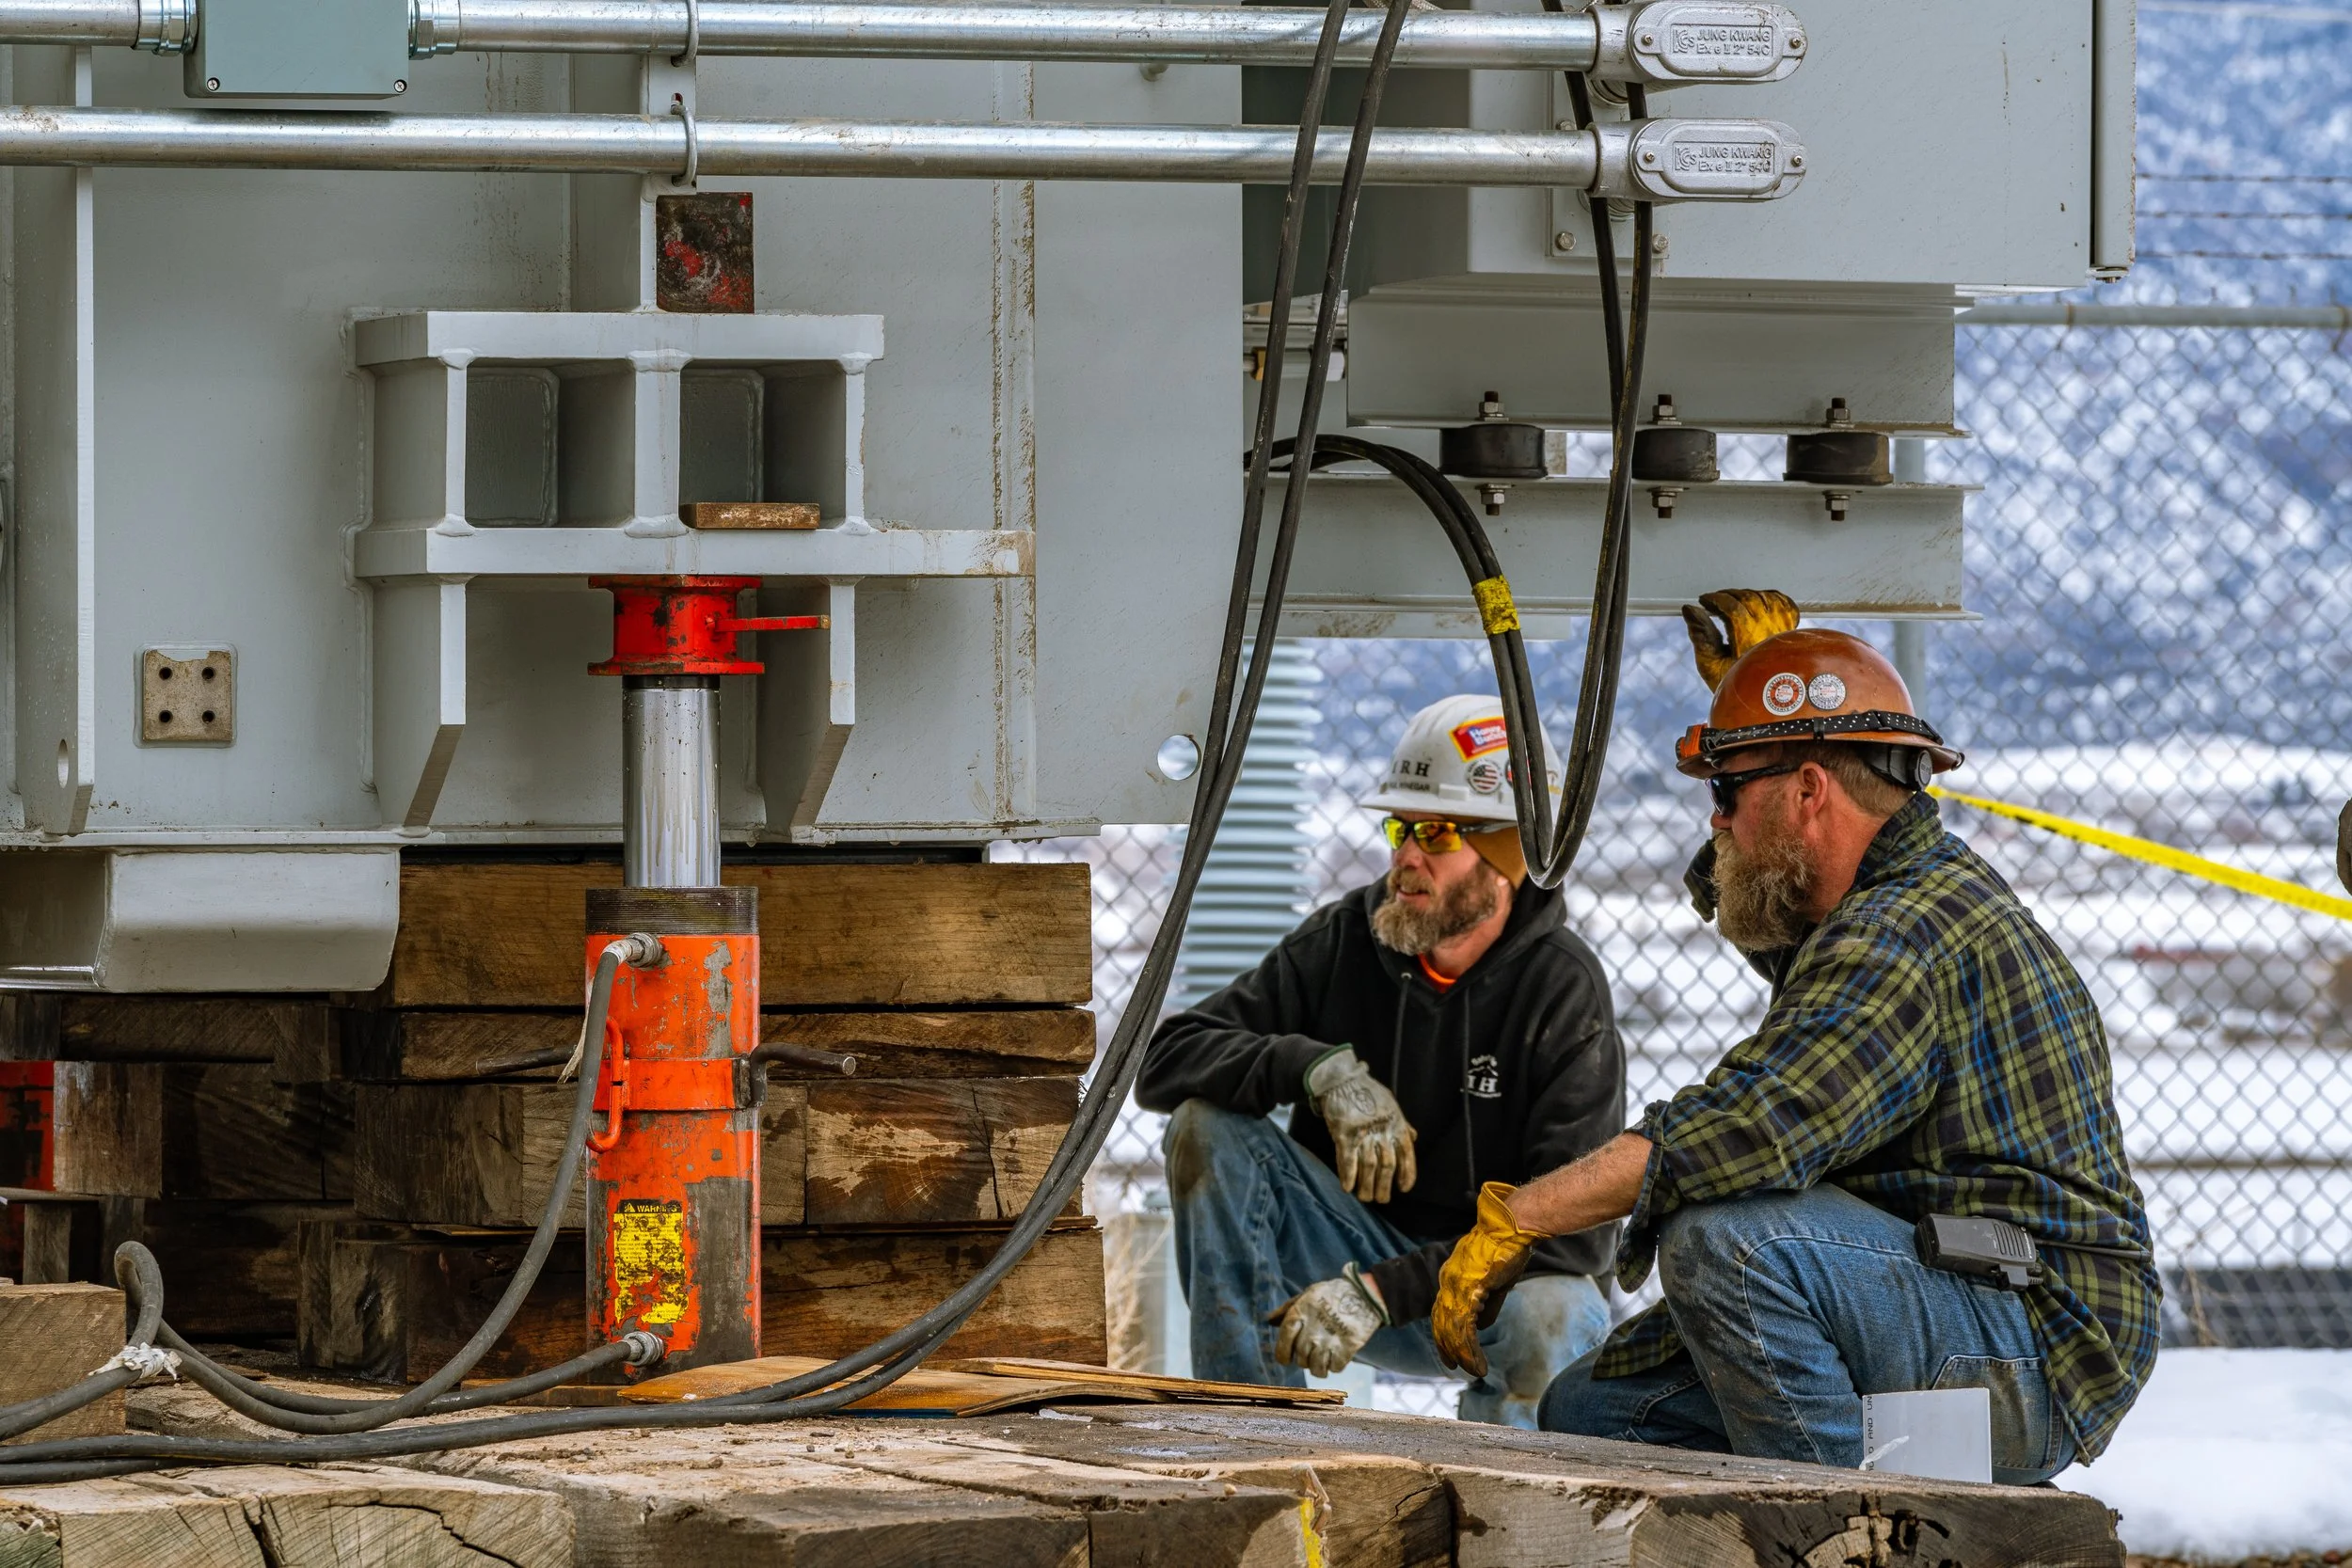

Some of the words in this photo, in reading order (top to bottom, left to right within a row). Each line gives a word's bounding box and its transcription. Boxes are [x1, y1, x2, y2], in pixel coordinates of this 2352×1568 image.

[1697, 28, 1727, 41] JUNG
[1730, 29, 1771, 42] KWANG
[1698, 146, 1729, 159] JUNG
[1731, 147, 1772, 159] KWANG
